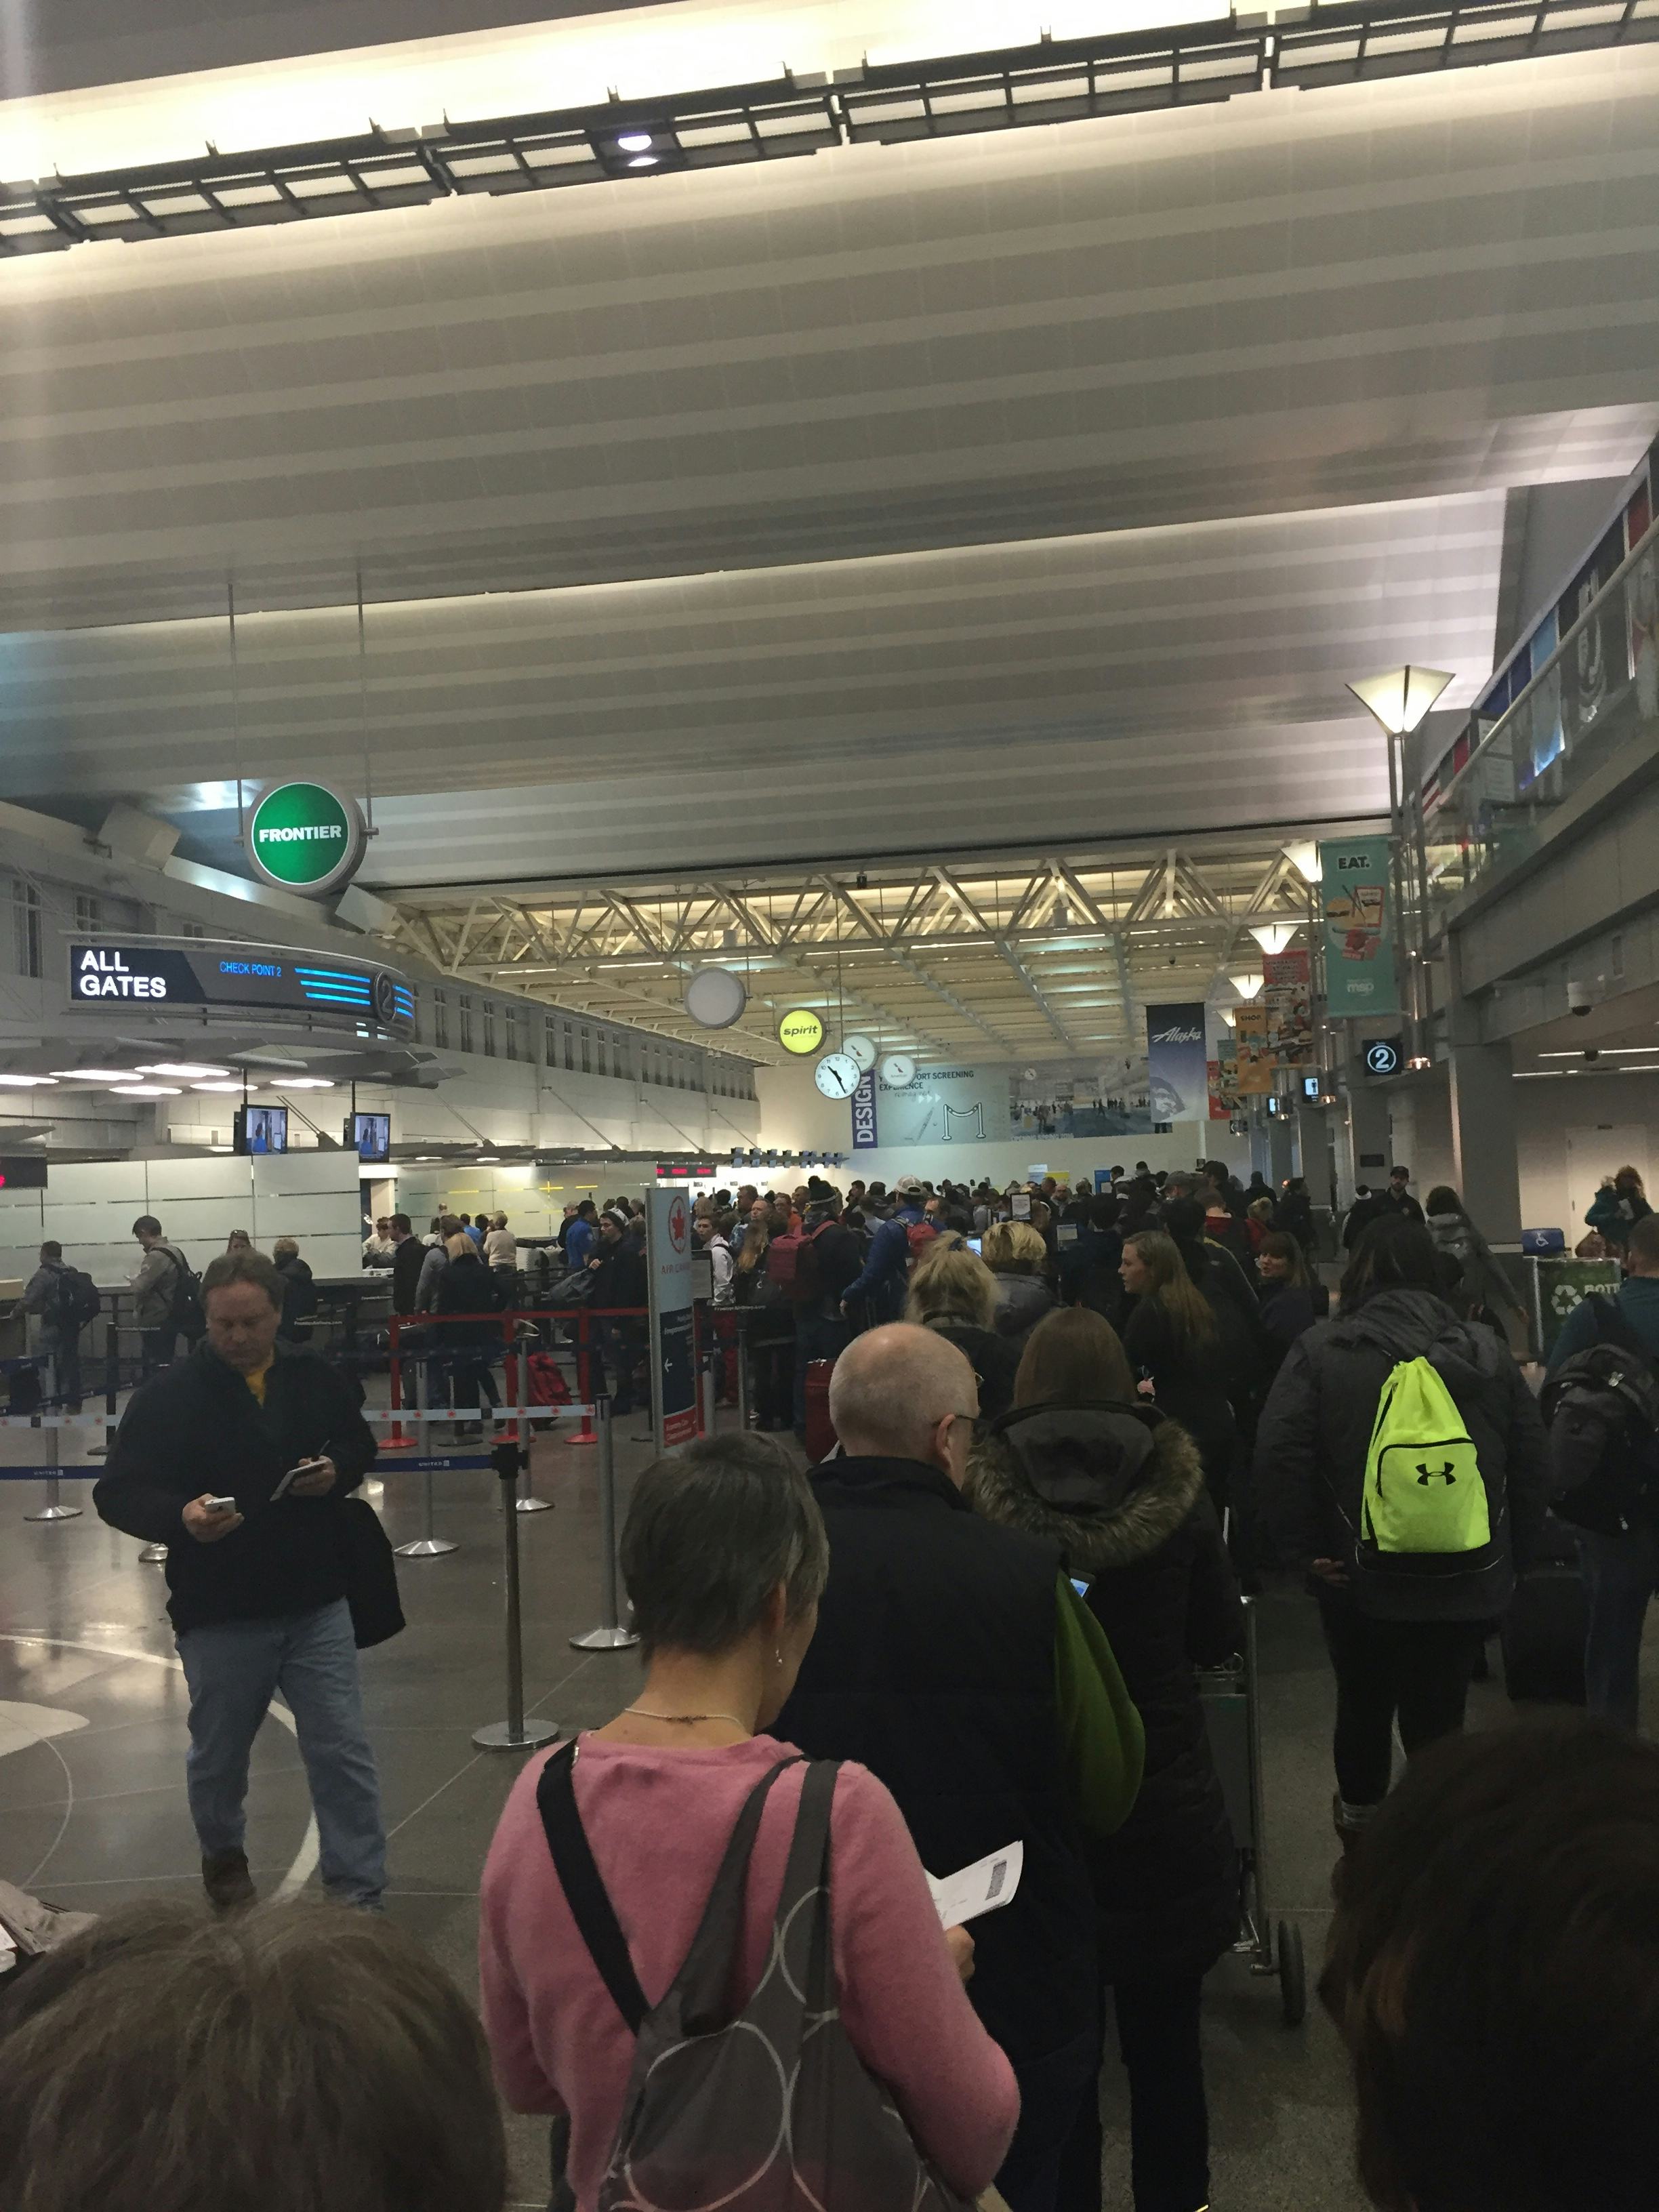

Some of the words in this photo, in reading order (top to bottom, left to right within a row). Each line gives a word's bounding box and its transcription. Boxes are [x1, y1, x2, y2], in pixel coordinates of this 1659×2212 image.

[259, 825, 342, 843] FRONTIER
[1338, 856, 1370, 870] EAT.
[80, 949, 129, 972] ALL
[220, 961, 250, 975] CHECK
[251, 964, 275, 977] POINT
[276, 966, 282, 977] 2
[80, 974, 167, 998] GATES
[783, 1025, 818, 1037] spirit
[1151, 1026, 1202, 1044] Alaska
[1375, 1048, 1389, 1069] 2
[932, 1070, 975, 1080] SCREENING
[855, 1076, 874, 1143] DESIGN
